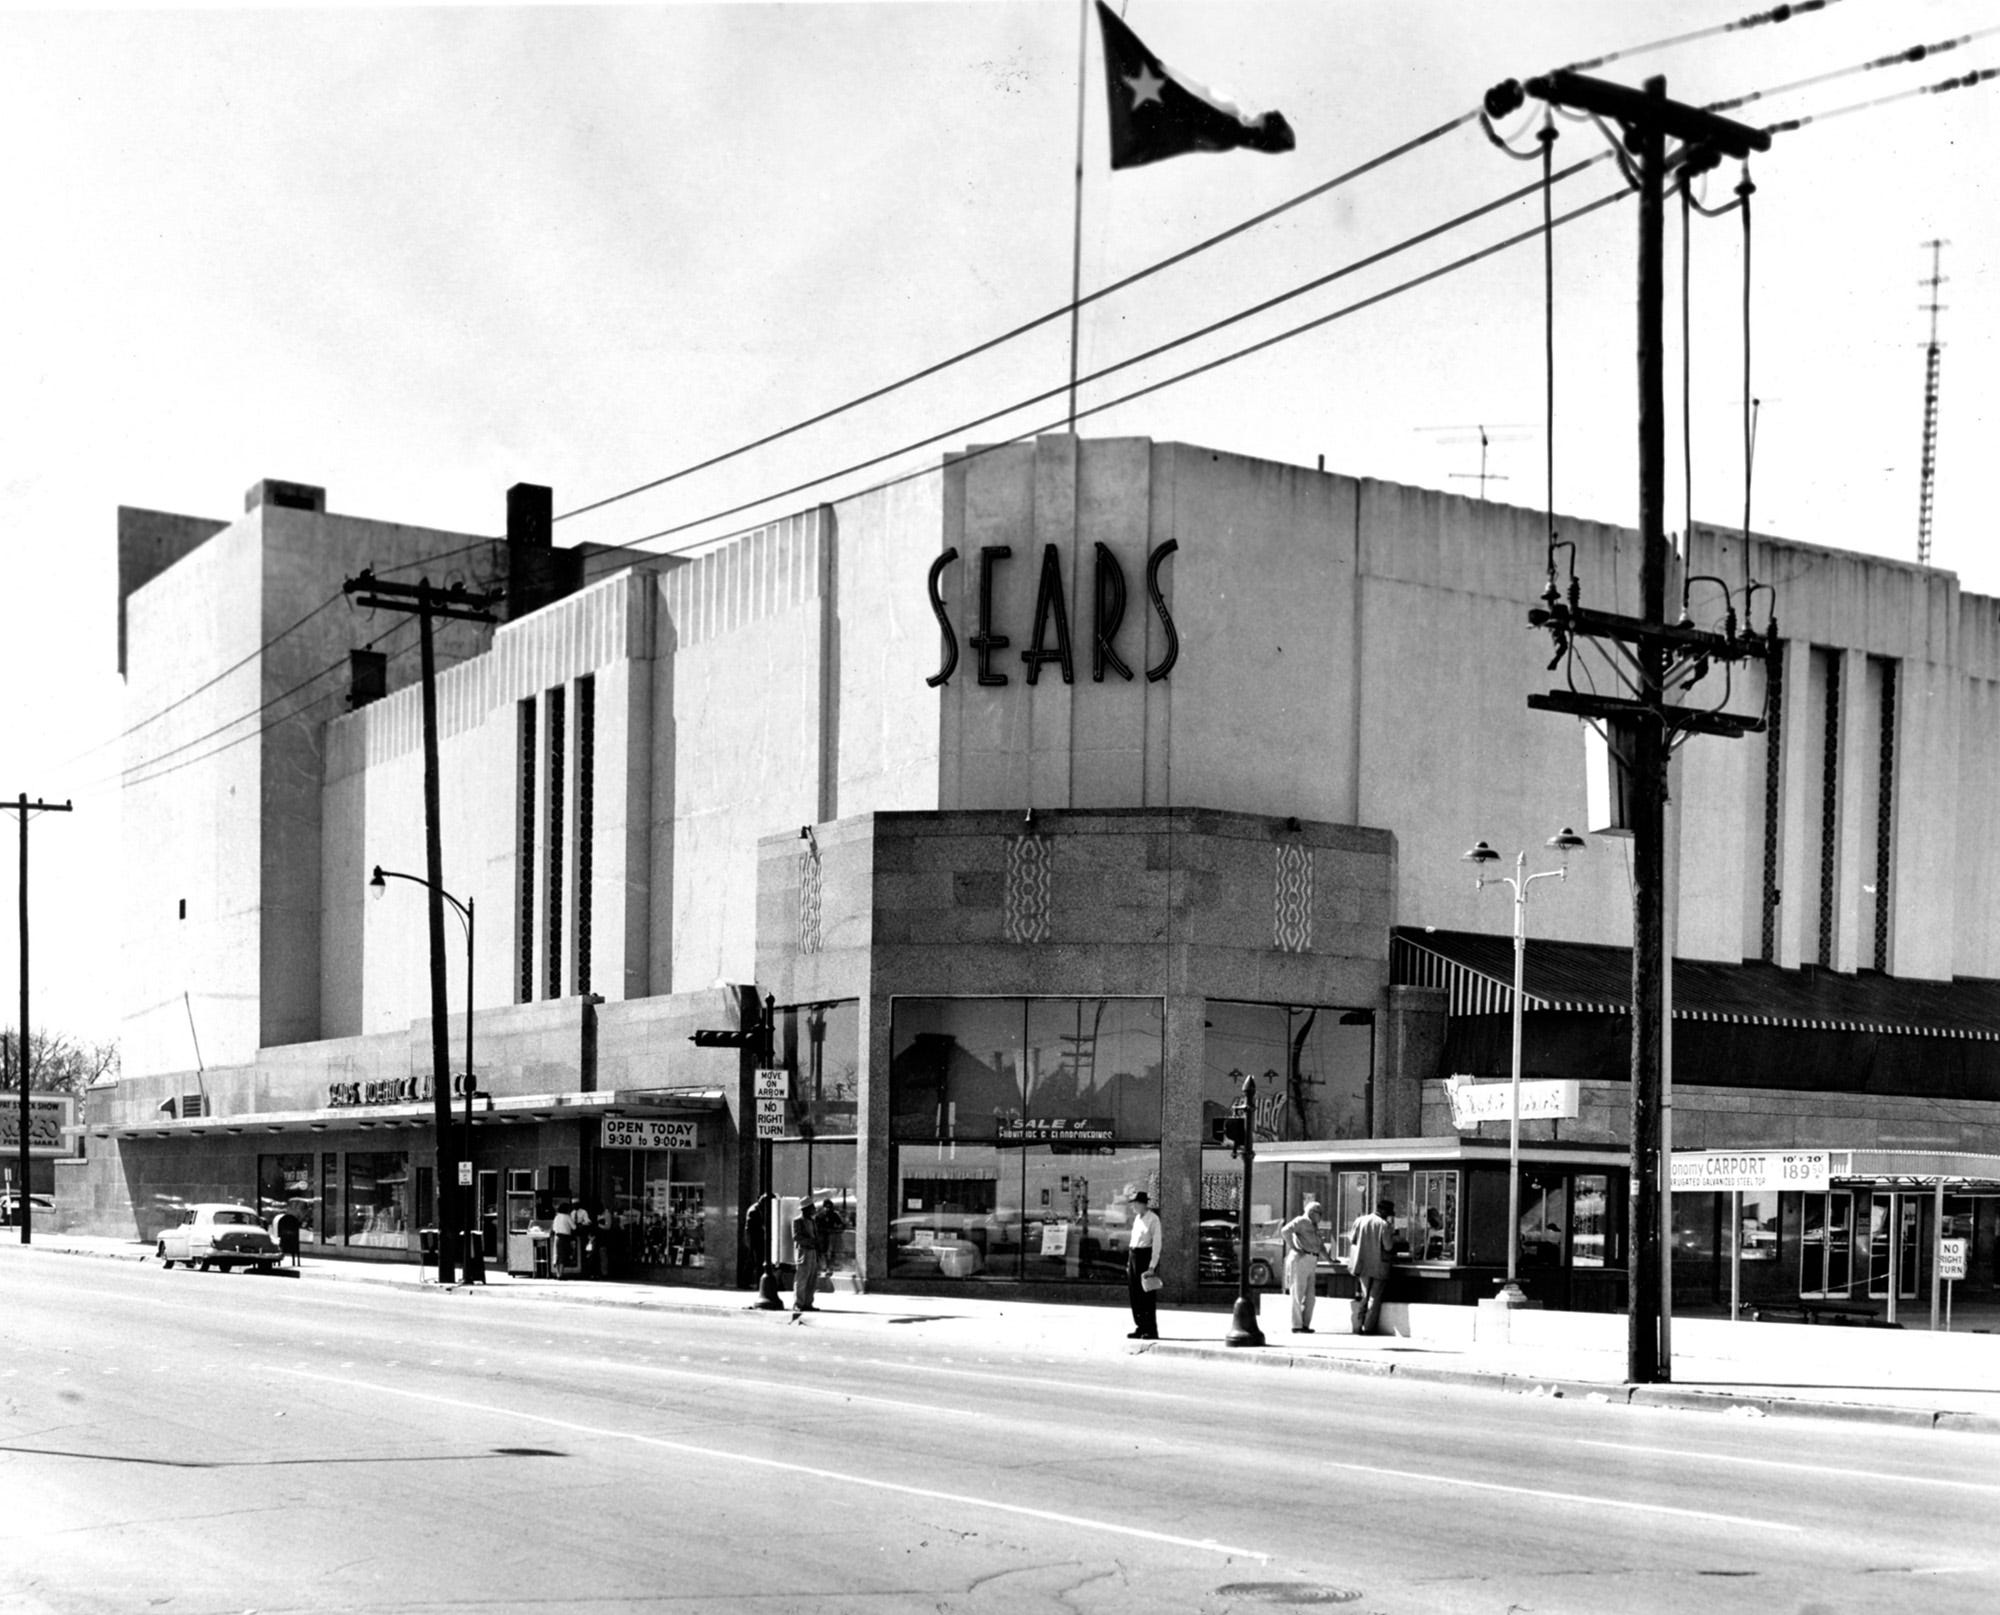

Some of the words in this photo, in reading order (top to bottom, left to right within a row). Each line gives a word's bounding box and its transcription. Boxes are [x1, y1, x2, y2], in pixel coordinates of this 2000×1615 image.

[926, 538, 1179, 687] SEARS
[761, 1071, 783, 1080] MOVE
[766, 1080, 777, 1088] ON
[758, 1088, 785, 1096] ARROW
[37, 1102, 59, 1110] SHOW
[764, 1102, 777, 1112] NO
[758, 1114, 783, 1124] RIGHT
[1012, 1119, 1066, 1129] SALE
[1074, 1119, 1088, 1129] of
[607, 1121, 643, 1134] OPEN
[649, 1123, 694, 1135] TODAY
[759, 1125, 783, 1135] TURN
[608, 1134, 632, 1145] 9:30
[638, 1135, 648, 1146] to
[1671, 1163, 1704, 1177] onomy
[1706, 1157, 1766, 1176] CARPORT
[1943, 1244, 1959, 1254] NO
[1939, 1255, 1962, 1264] RIGHT
